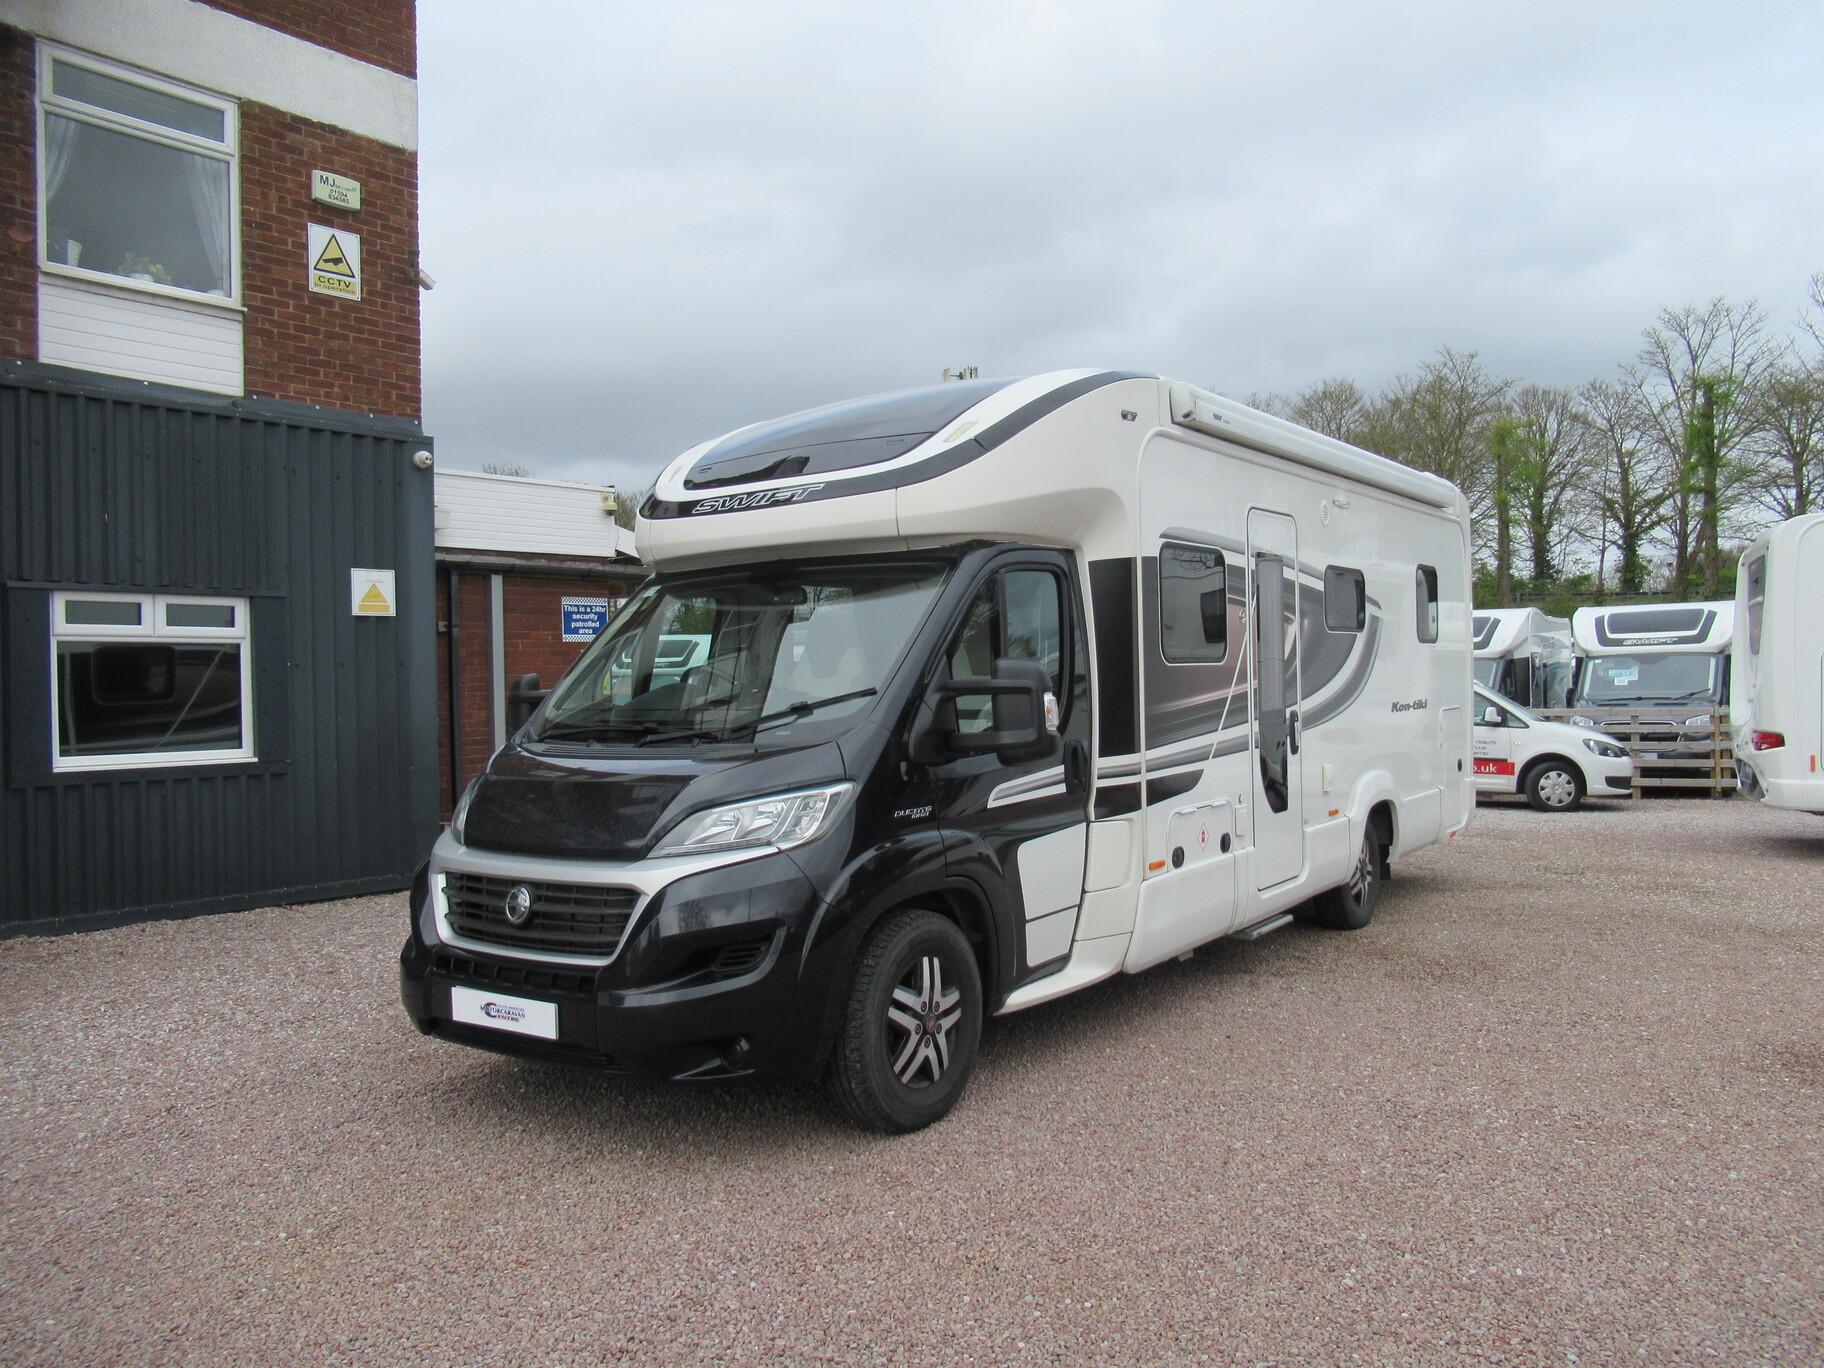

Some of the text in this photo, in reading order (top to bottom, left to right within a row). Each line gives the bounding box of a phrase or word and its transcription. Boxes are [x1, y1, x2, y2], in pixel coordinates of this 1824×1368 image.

[319, 174, 336, 187] MJ
[318, 275, 352, 289] CCTV
[692, 483, 826, 514] SWIFT
[572, 613, 599, 621] security
[571, 620, 600, 629] patrolled
[1622, 637, 1679, 646] SWIFT
